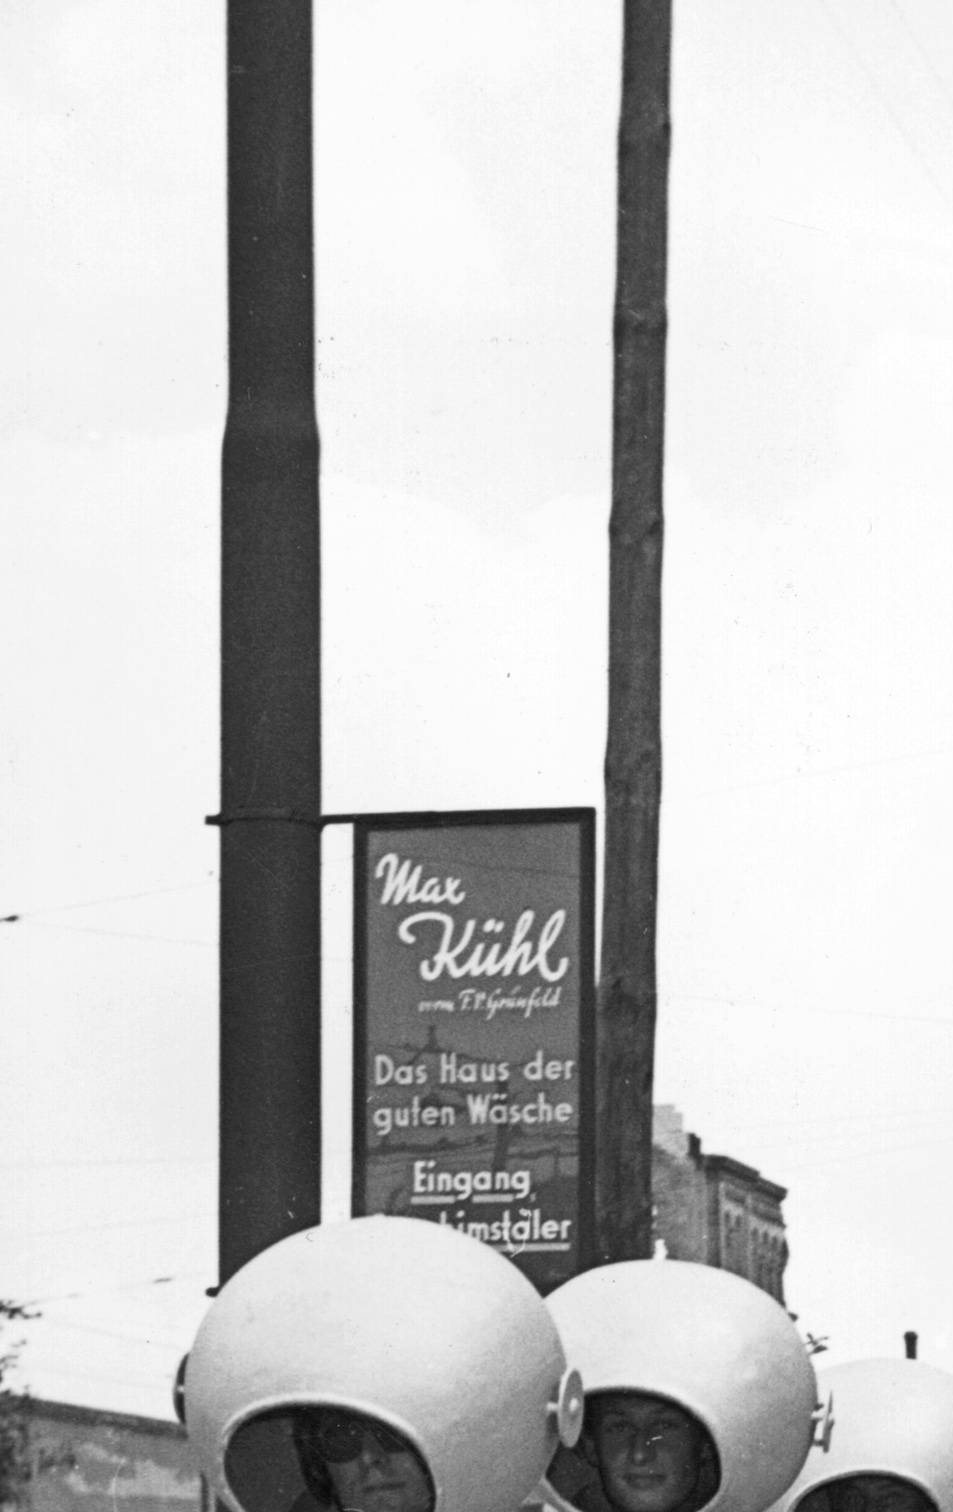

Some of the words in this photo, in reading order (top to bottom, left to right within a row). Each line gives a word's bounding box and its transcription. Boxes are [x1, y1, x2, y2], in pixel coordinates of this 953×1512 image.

[375, 853, 465, 905] Max
[398, 909, 569, 982] Kühl
[374, 1055, 427, 1086] Das
[440, 1053, 510, 1084] Haus
[523, 1050, 575, 1082] der
[373, 1096, 456, 1135] guten
[466, 1092, 574, 1125] Wäsche
[412, 1160, 532, 1201] Eingang
